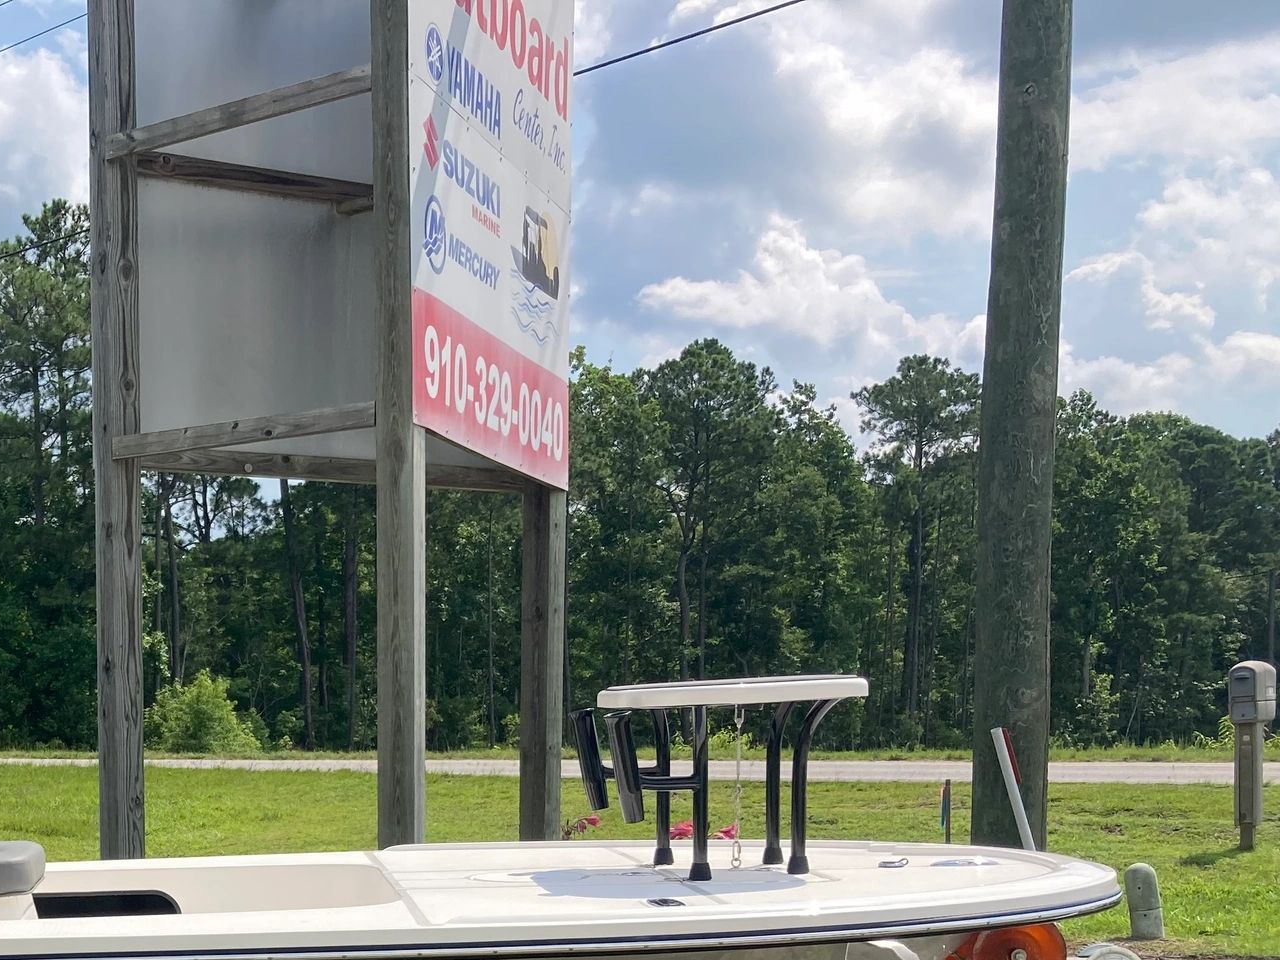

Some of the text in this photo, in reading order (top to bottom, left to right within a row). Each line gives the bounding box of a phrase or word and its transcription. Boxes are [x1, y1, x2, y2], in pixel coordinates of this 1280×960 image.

[447, 40, 502, 140] YAMAHA
[455, 0, 568, 122] board
[513, 88, 566, 175] Center, Inc.
[442, 140, 501, 219] SUZUKI
[471, 203, 502, 239] MARINE
[448, 233, 500, 291] MERCURY
[424, 325, 563, 461] 910-329-0040
